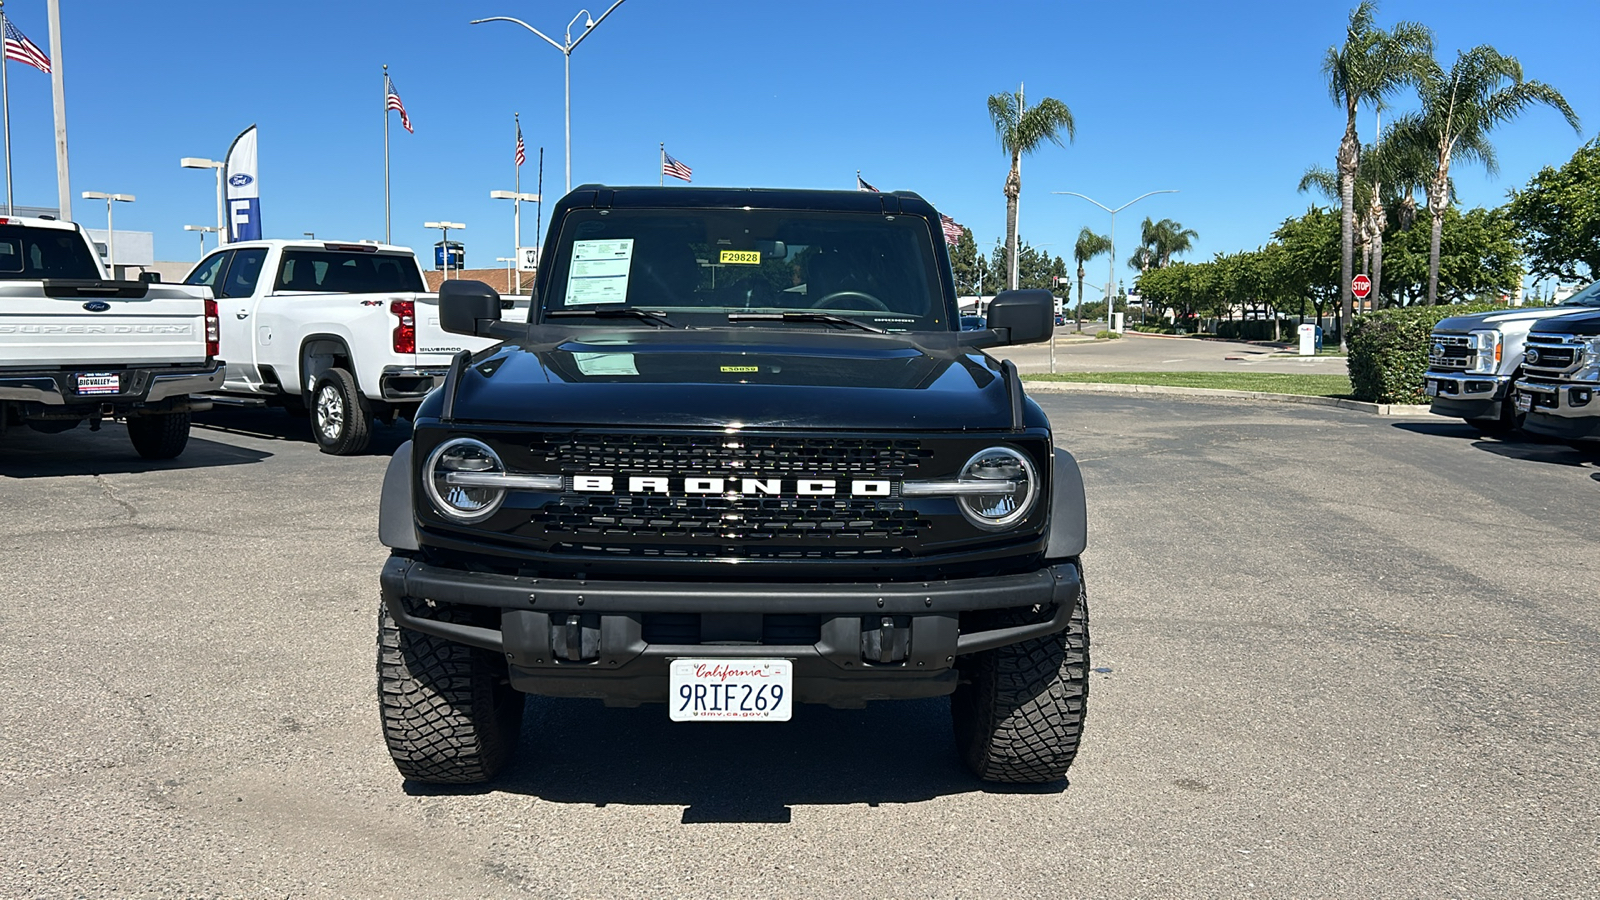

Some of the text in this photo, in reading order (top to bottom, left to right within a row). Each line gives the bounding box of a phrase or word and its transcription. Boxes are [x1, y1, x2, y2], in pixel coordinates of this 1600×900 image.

[230, 200, 250, 238] F
[722, 252, 758, 262] F29828
[1353, 281, 1370, 291] STOP
[113, 325, 189, 334] DUTY
[572, 475, 892, 496] BRONCO
[696, 663, 770, 682] California
[679, 684, 784, 711] 9RIF269
